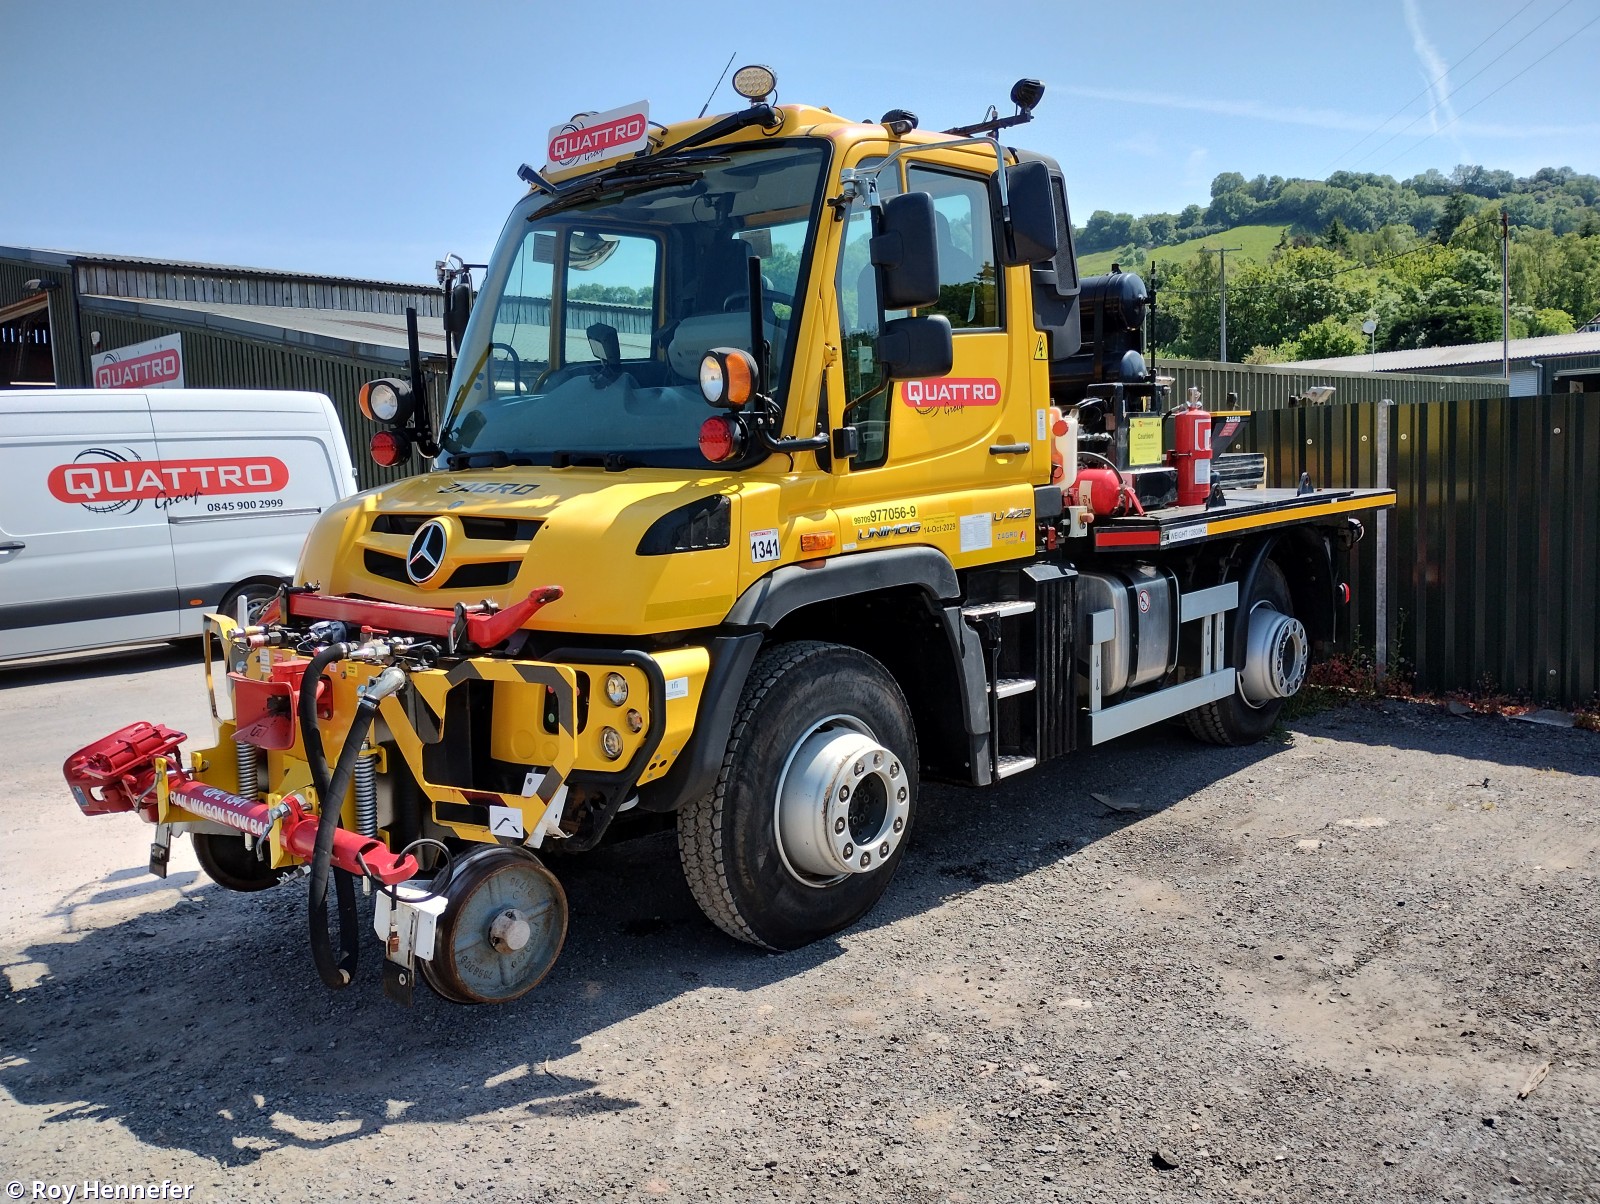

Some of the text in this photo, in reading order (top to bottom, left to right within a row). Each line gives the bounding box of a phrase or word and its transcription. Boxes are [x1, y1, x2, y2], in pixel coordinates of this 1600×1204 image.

[554, 120, 640, 158] QUATTRO
[99, 356, 176, 388] QUATTRO
[907, 381, 996, 405] QUATTRO
[64, 464, 272, 499] QUATTRO
[437, 483, 541, 496] ZAGRO
[154, 487, 204, 511] Group
[207, 498, 284, 512] 0845 900 2999
[992, 507, 1031, 522] U 423
[857, 521, 921, 540] UNIMOG
[751, 538, 779, 559] 1341
[169, 791, 190, 807] RAIL
[190, 798, 225, 822] WAGON
[226, 811, 249, 830] TOW
